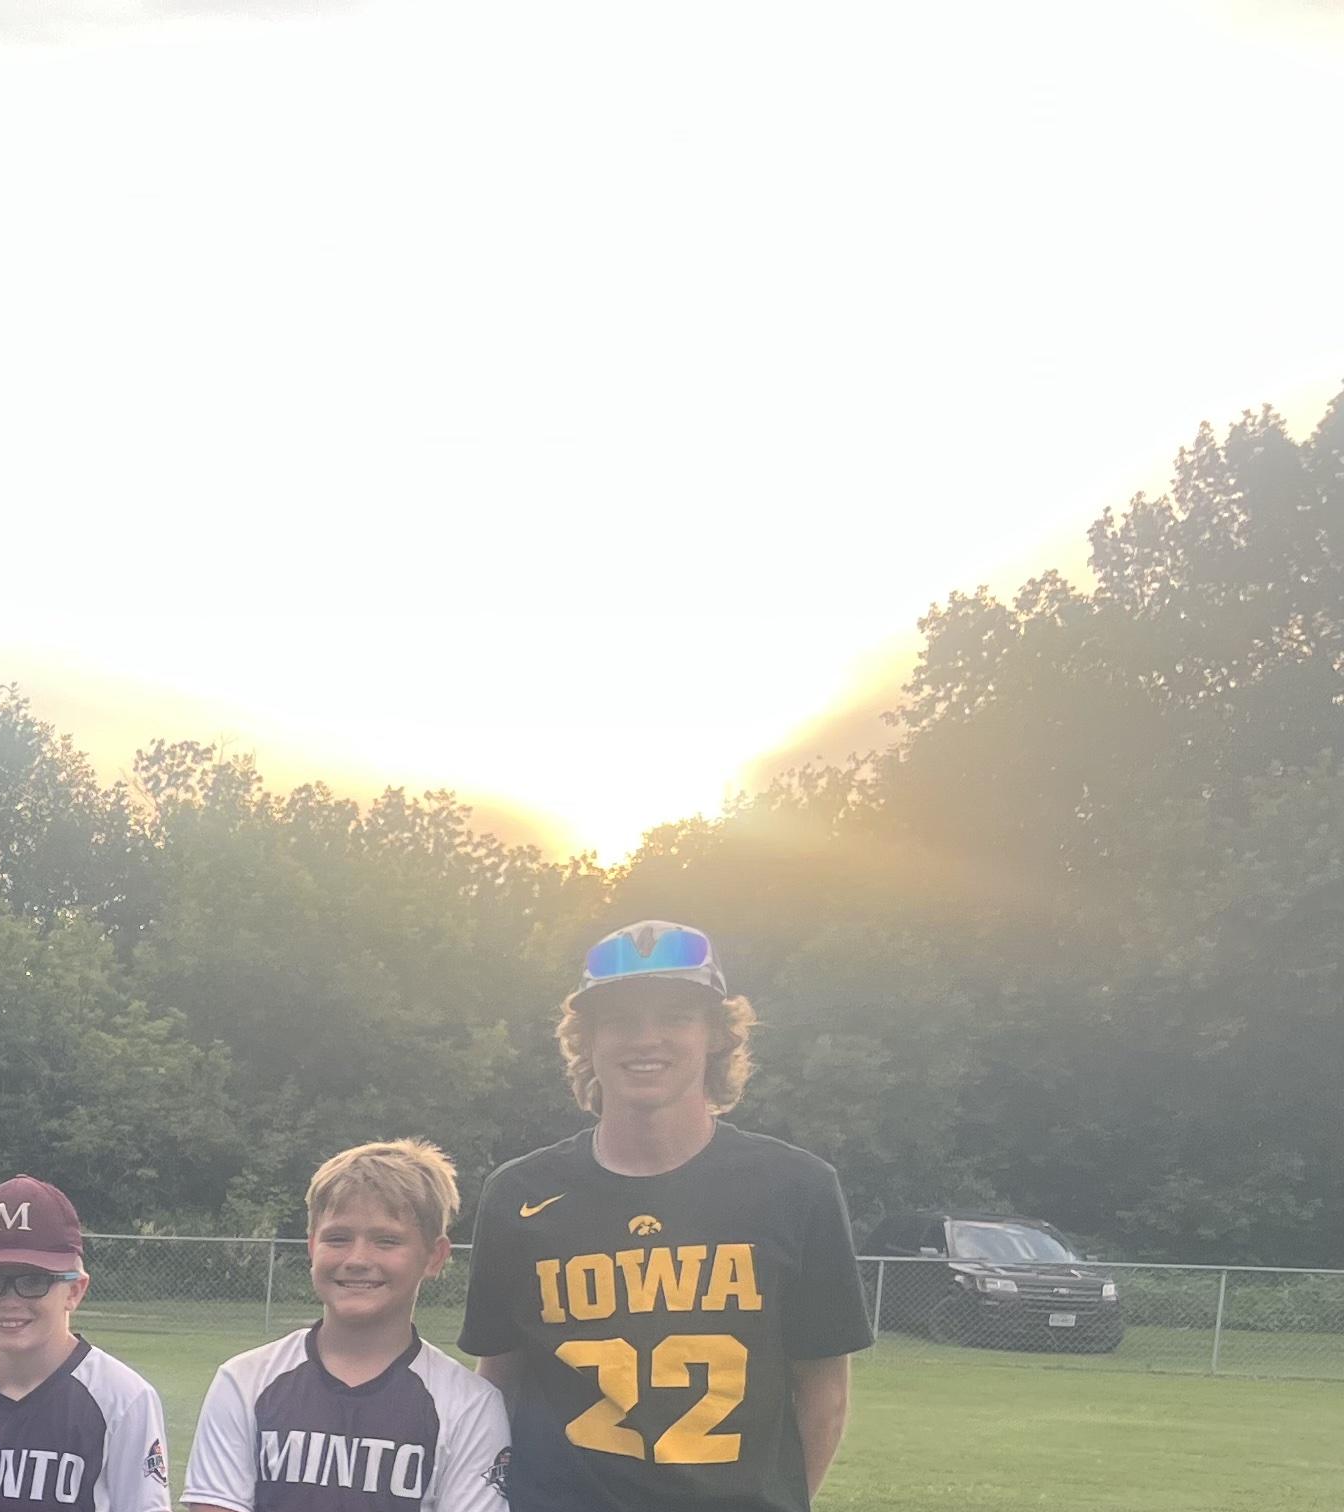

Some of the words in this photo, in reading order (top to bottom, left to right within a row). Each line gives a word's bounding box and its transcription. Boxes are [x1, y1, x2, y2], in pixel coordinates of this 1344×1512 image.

[535, 1242, 764, 1324] IOWA
[554, 1334, 749, 1465] 22
[260, 1430, 425, 1499] MINTO
